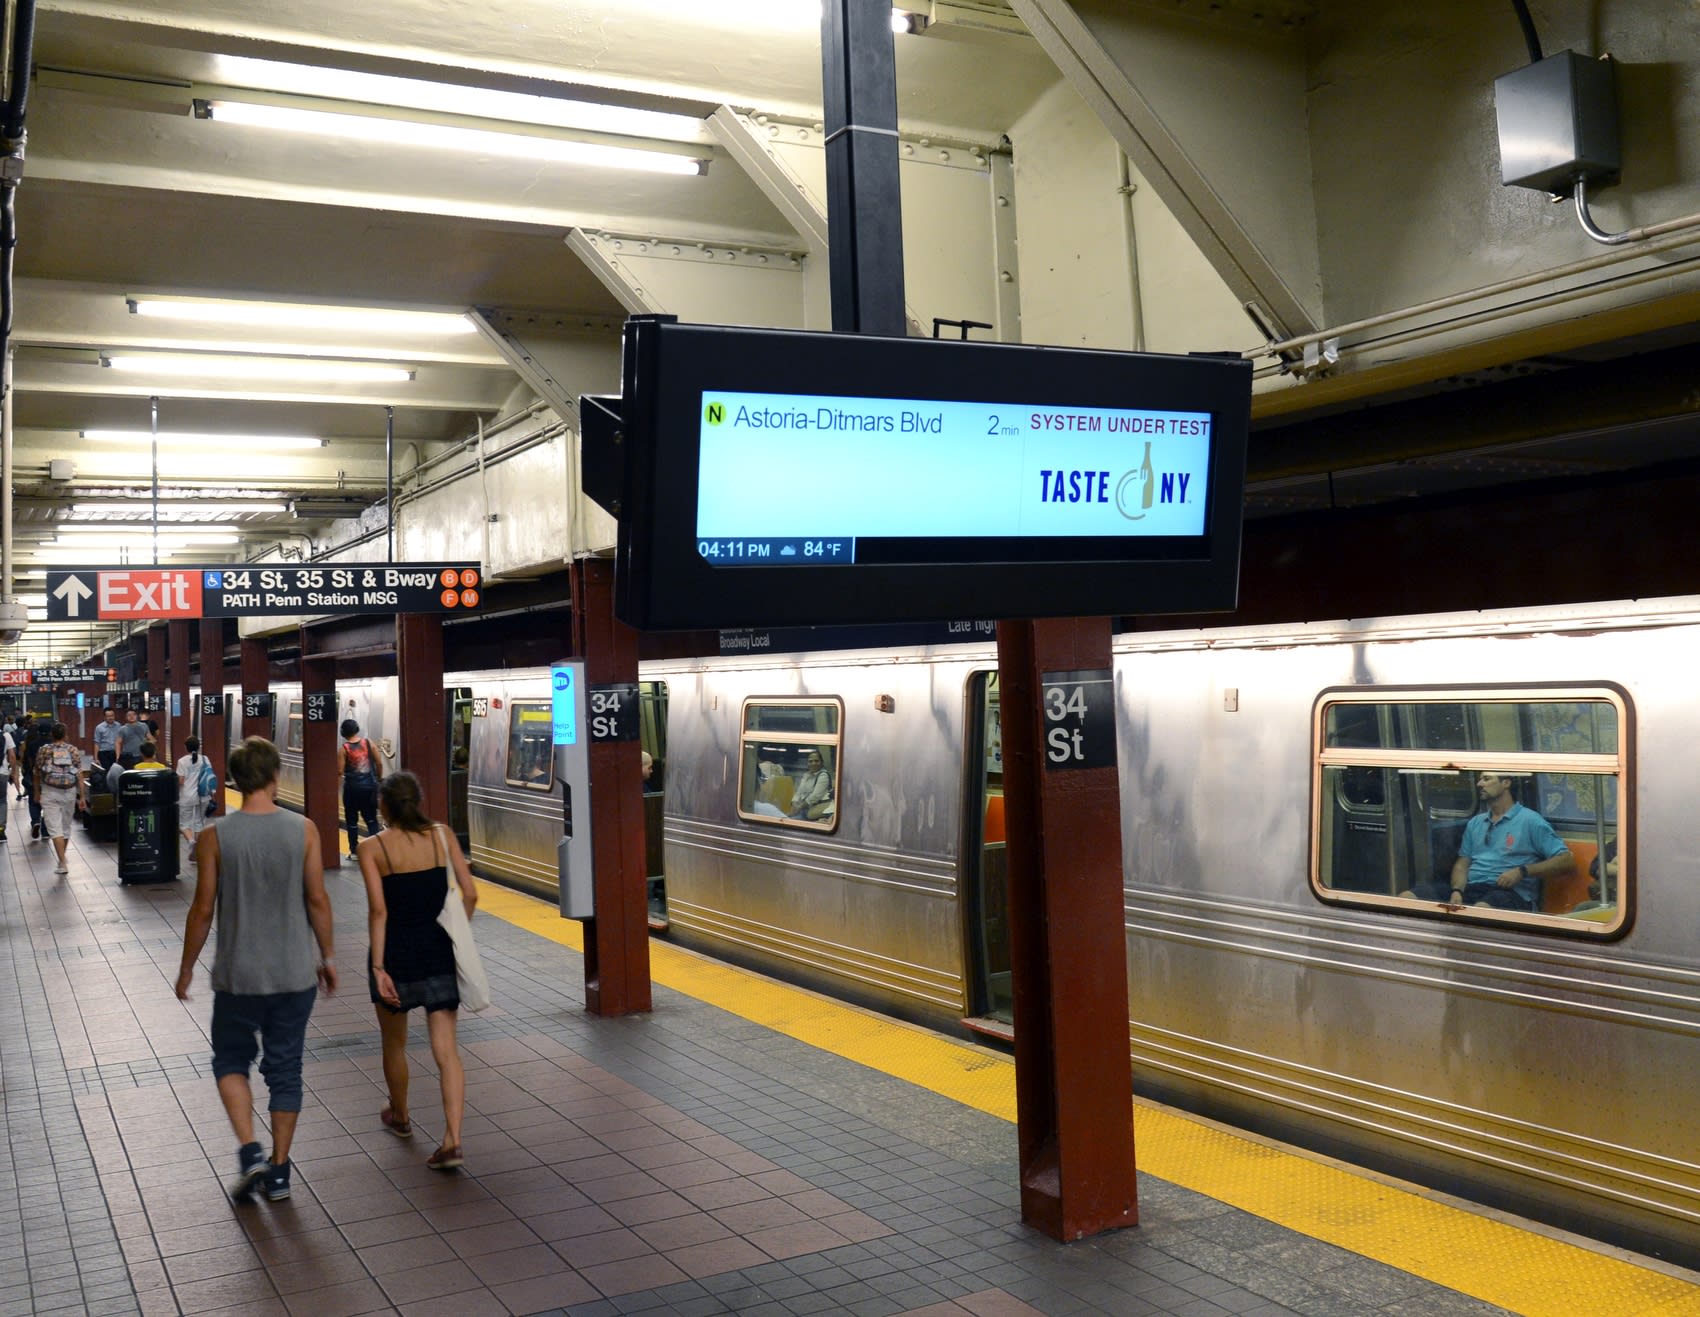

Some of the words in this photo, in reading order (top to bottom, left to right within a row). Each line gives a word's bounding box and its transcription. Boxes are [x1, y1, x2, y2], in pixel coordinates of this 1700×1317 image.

[709, 405, 722, 423] N
[734, 405, 894, 432] Astoria-Ditmars
[900, 411, 942, 434] Blvd
[987, 415, 1000, 436] 2
[1001, 425, 1020, 436] min
[1031, 413, 1101, 432] SYSTEM
[1107, 416, 1165, 434] UNDER
[1169, 419, 1210, 436] TEST
[1040, 470, 1110, 503] TASTE
[1160, 472, 1191, 503] NY
[698, 541, 744, 558] 04:11
[748, 543, 770, 557] PM
[804, 541, 824, 557] 84
[99, 572, 191, 612] Exit
[222, 571, 252, 590] 34
[260, 570, 288, 592] St,
[296, 570, 324, 589] 35
[331, 570, 355, 588] St
[361, 569, 377, 588] &
[385, 569, 437, 590] Bway
[445, 573, 454, 584] B
[465, 573, 475, 584] D
[222, 594, 260, 608] PATH
[265, 593, 302, 606] Penn
[307, 592, 359, 606] Station
[363, 591, 398, 605] MSG
[948, 620, 971, 633] Late
[720, 635, 750, 650] Broadway
[750, 633, 770, 648] Local
[0, 671, 28, 684] Exit
[149, 696, 160, 704] 34
[203, 696, 217, 705] 34
[246, 695, 261, 706] 34
[308, 695, 326, 708] 34
[592, 692, 621, 714] 34
[1046, 686, 1088, 721] 34
[203, 705, 215, 714] St
[246, 707, 259, 717] St
[308, 708, 324, 721] St
[554, 722, 570, 731] Help
[592, 716, 618, 738] St
[554, 730, 573, 739] Point
[1048, 727, 1085, 763] St
